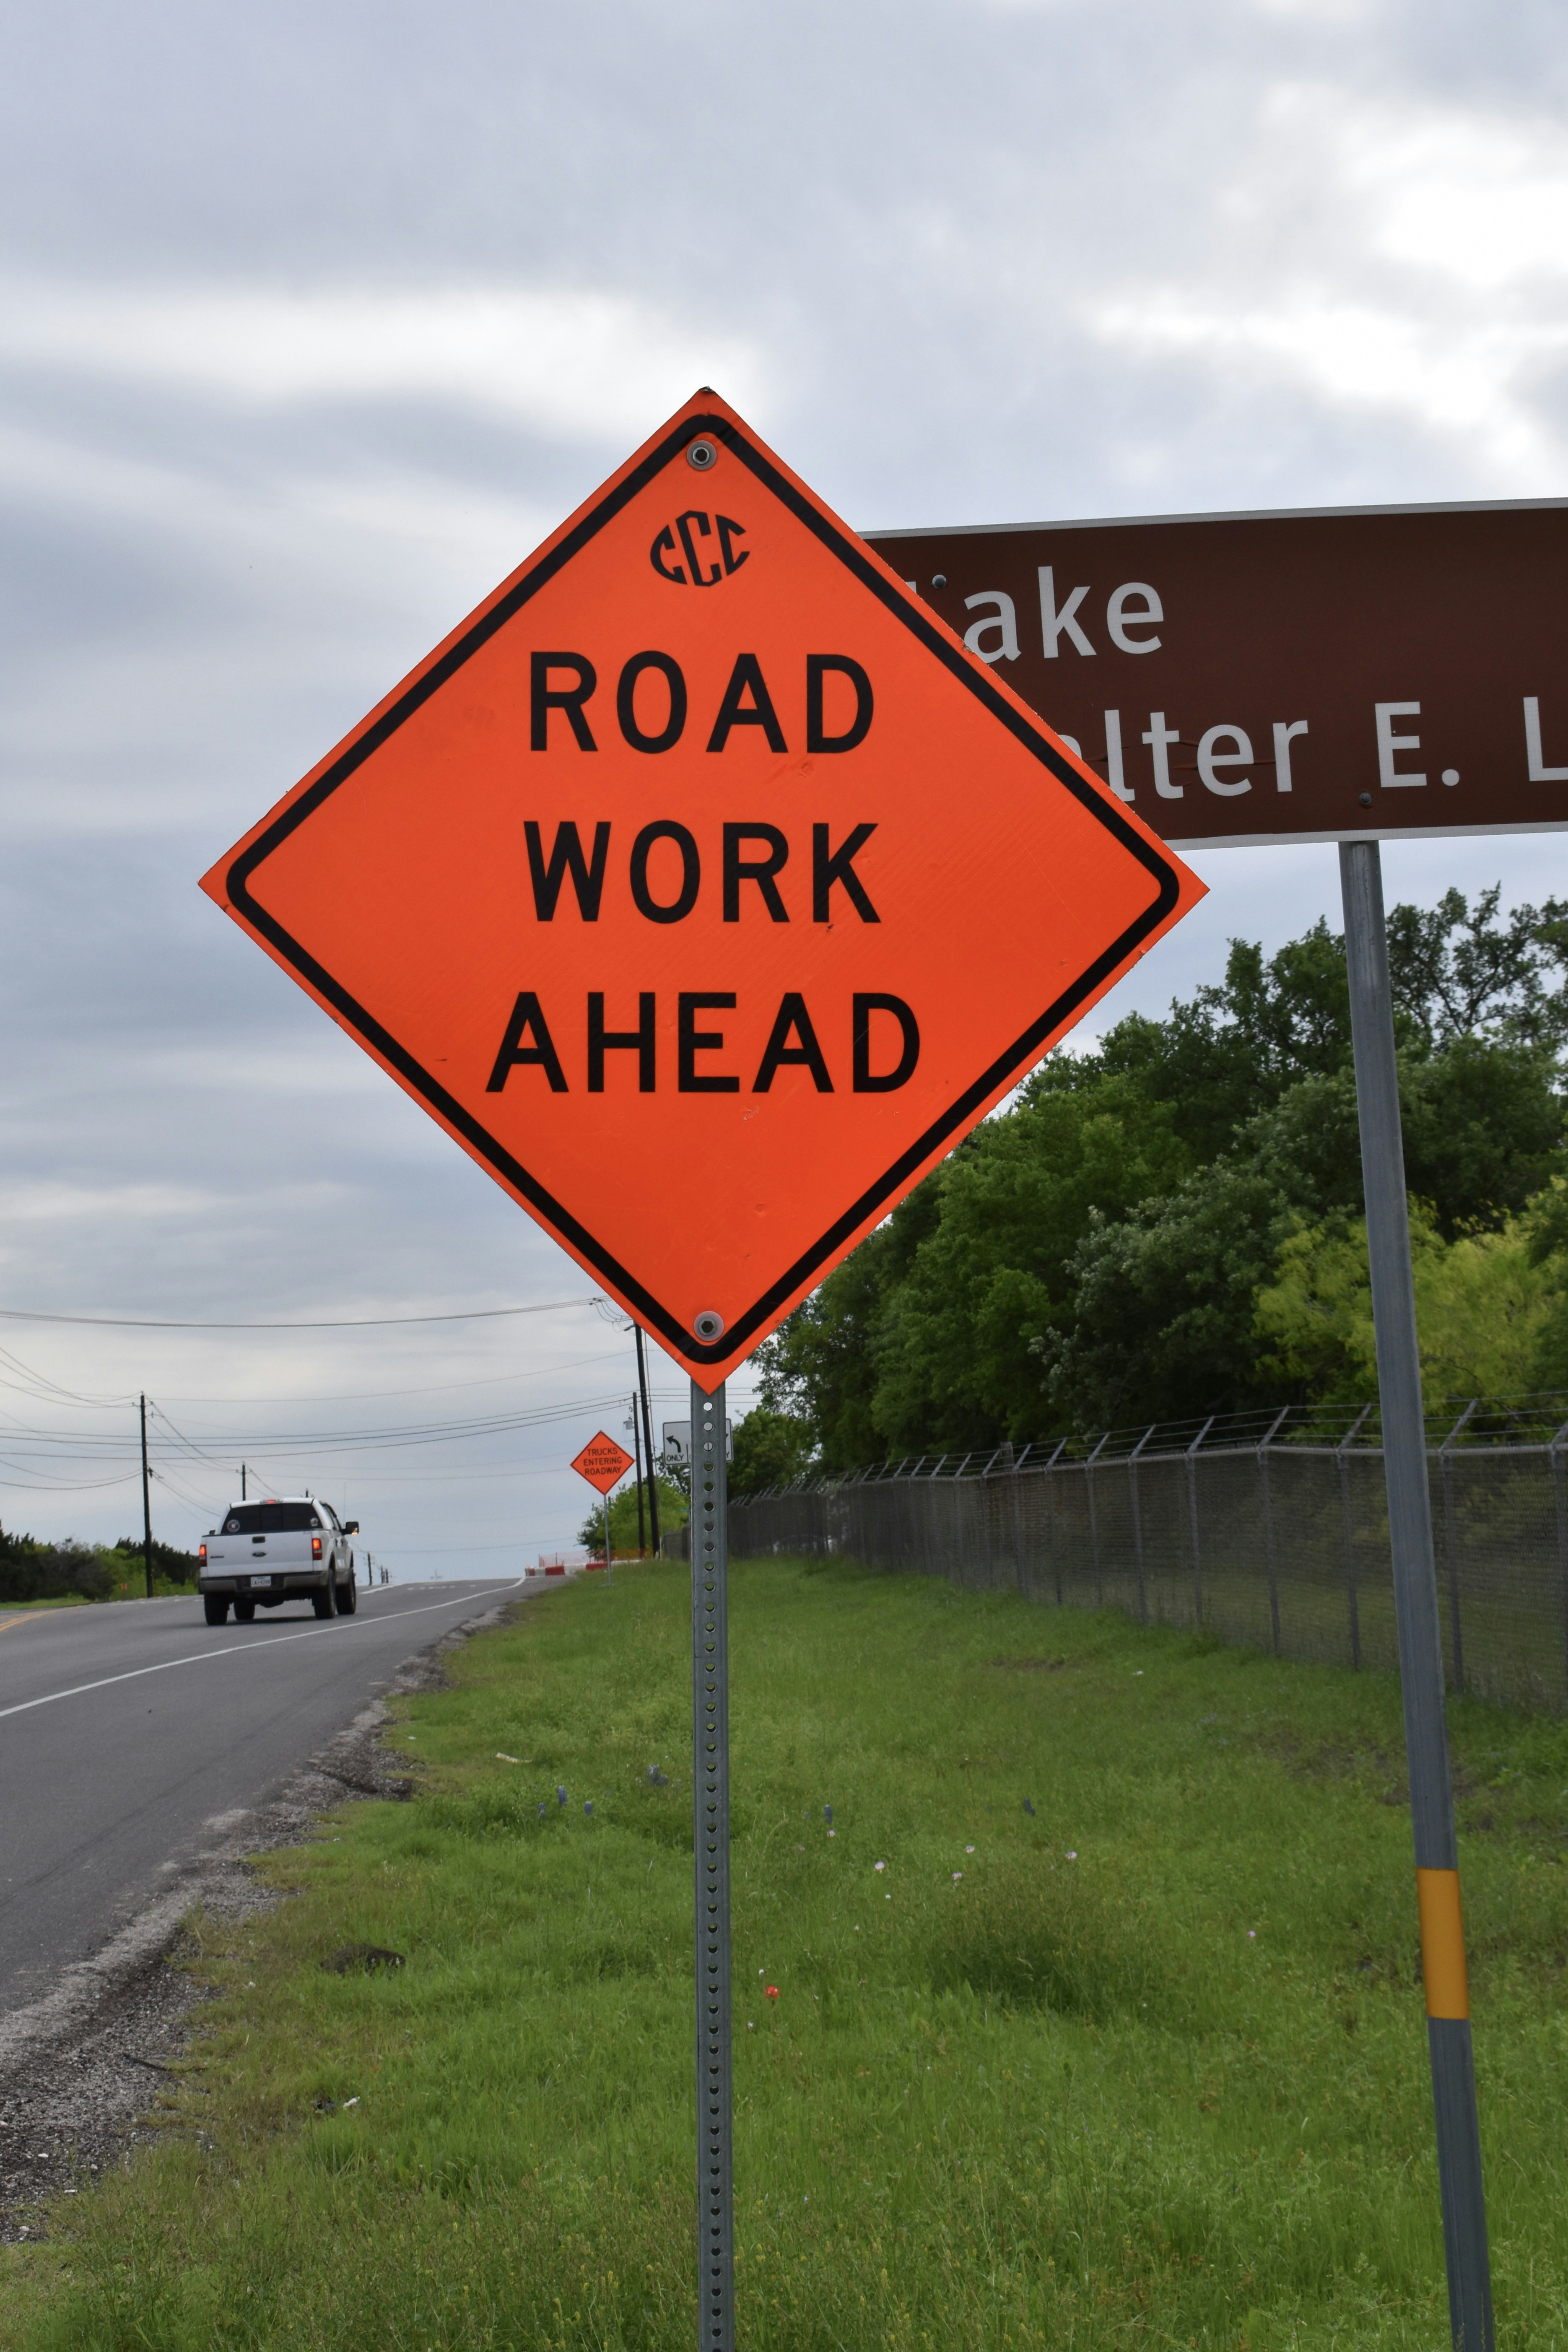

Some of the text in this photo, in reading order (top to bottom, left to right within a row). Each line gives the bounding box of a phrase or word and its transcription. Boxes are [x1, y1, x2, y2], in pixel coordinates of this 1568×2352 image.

[650, 510, 750, 587] CCC
[905, 566, 1164, 664] ake
[530, 650, 874, 753] ROAD
[1057, 697, 1568, 802] lter E. L
[524, 820, 881, 924] WORK
[485, 992, 920, 1093] AHEAD
[583, 1456, 622, 1466] ENTERING
[584, 1466, 621, 1476] ROADWAY
[587, 1447, 618, 1456] TRUCKS
